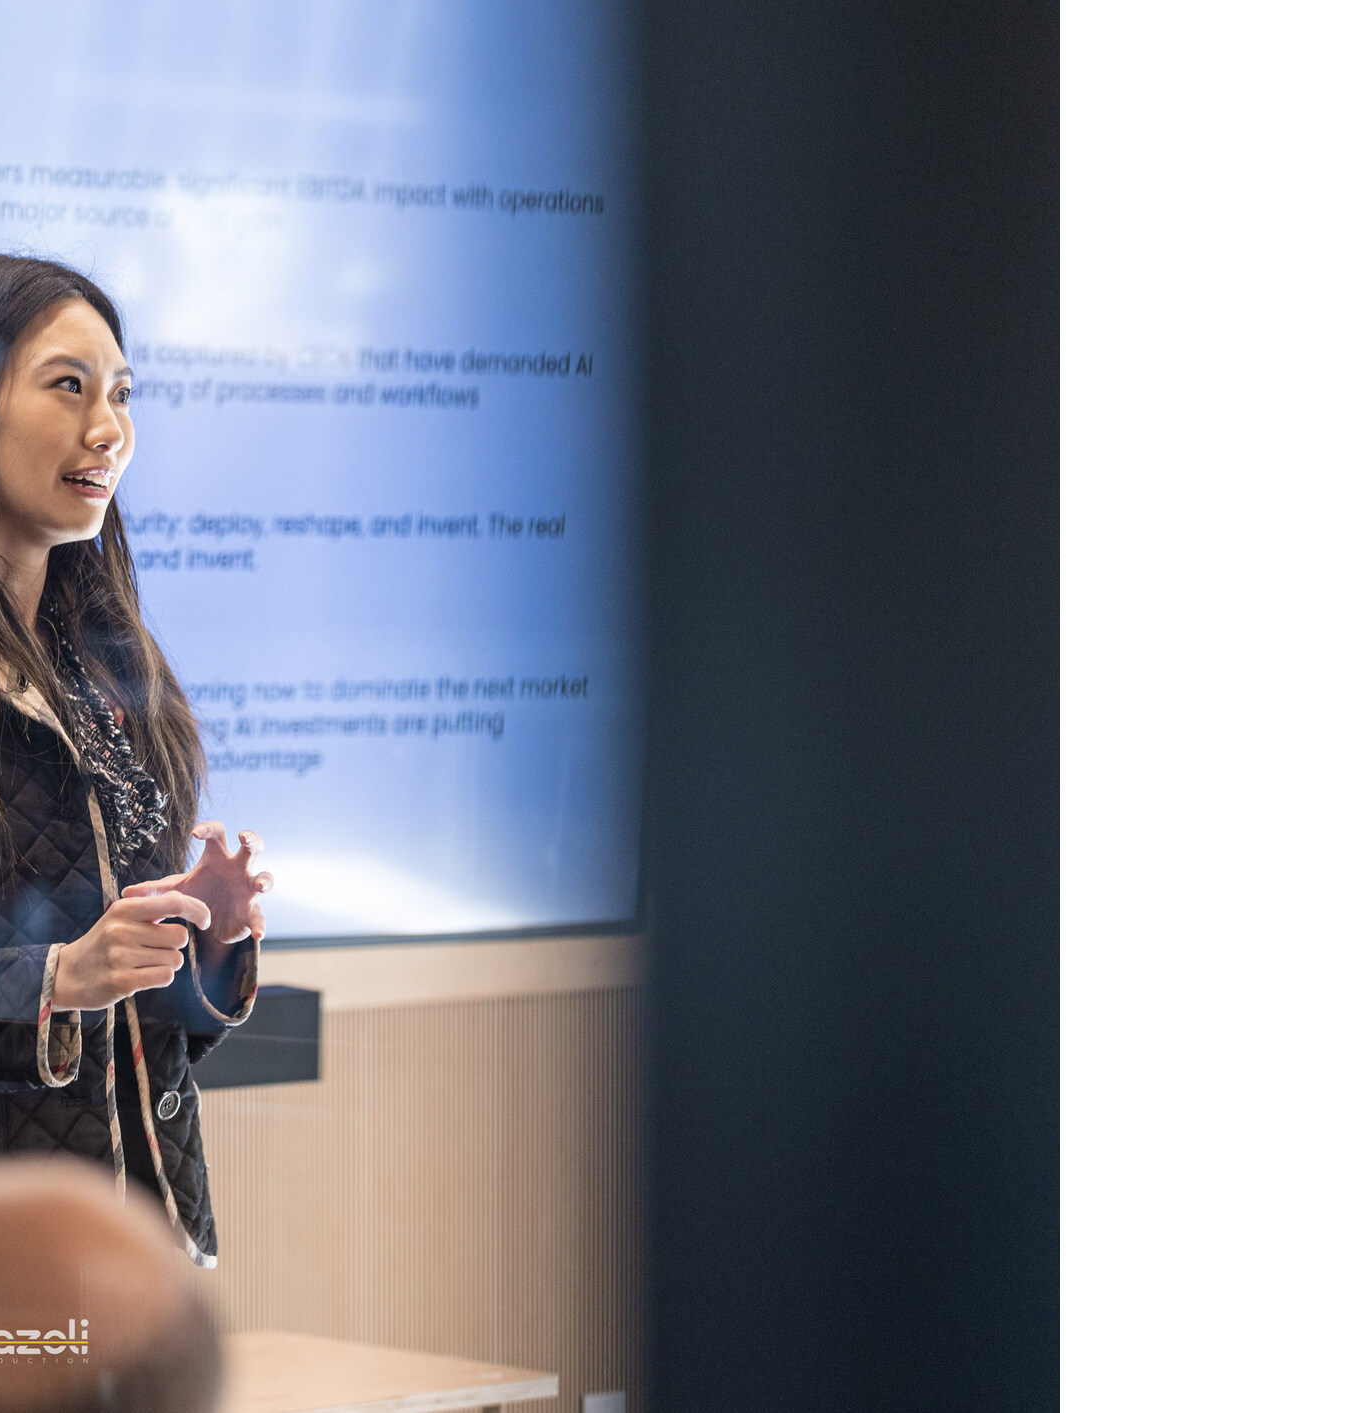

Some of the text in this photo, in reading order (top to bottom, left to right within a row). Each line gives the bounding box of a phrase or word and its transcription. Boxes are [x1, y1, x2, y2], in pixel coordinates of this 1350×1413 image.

[0, 199, 66, 231] major
[74, 206, 149, 229] source
[374, 181, 447, 212] impact
[452, 181, 495, 212] with
[499, 187, 604, 221] operations
[359, 346, 400, 373] that
[405, 346, 456, 374] have
[461, 346, 570, 377] demanded
[575, 352, 594, 377] AI
[189, 376, 214, 399] of
[215, 380, 326, 409] processes
[332, 379, 376, 405] and
[381, 381, 480, 410] workflows
[371, 511, 413, 539] and
[488, 511, 523, 539] The
[528, 511, 566, 539] real
[137, 545, 182, 572] and
[254, 681, 296, 701] now
[332, 675, 431, 702] dominate
[436, 674, 469, 701] the
[473, 674, 515, 700] next
[520, 672, 588, 699] market
[260, 711, 388, 738] investments
[393, 714, 428, 736] are
[432, 709, 506, 743] putting
[207, 747, 322, 779] advantage
